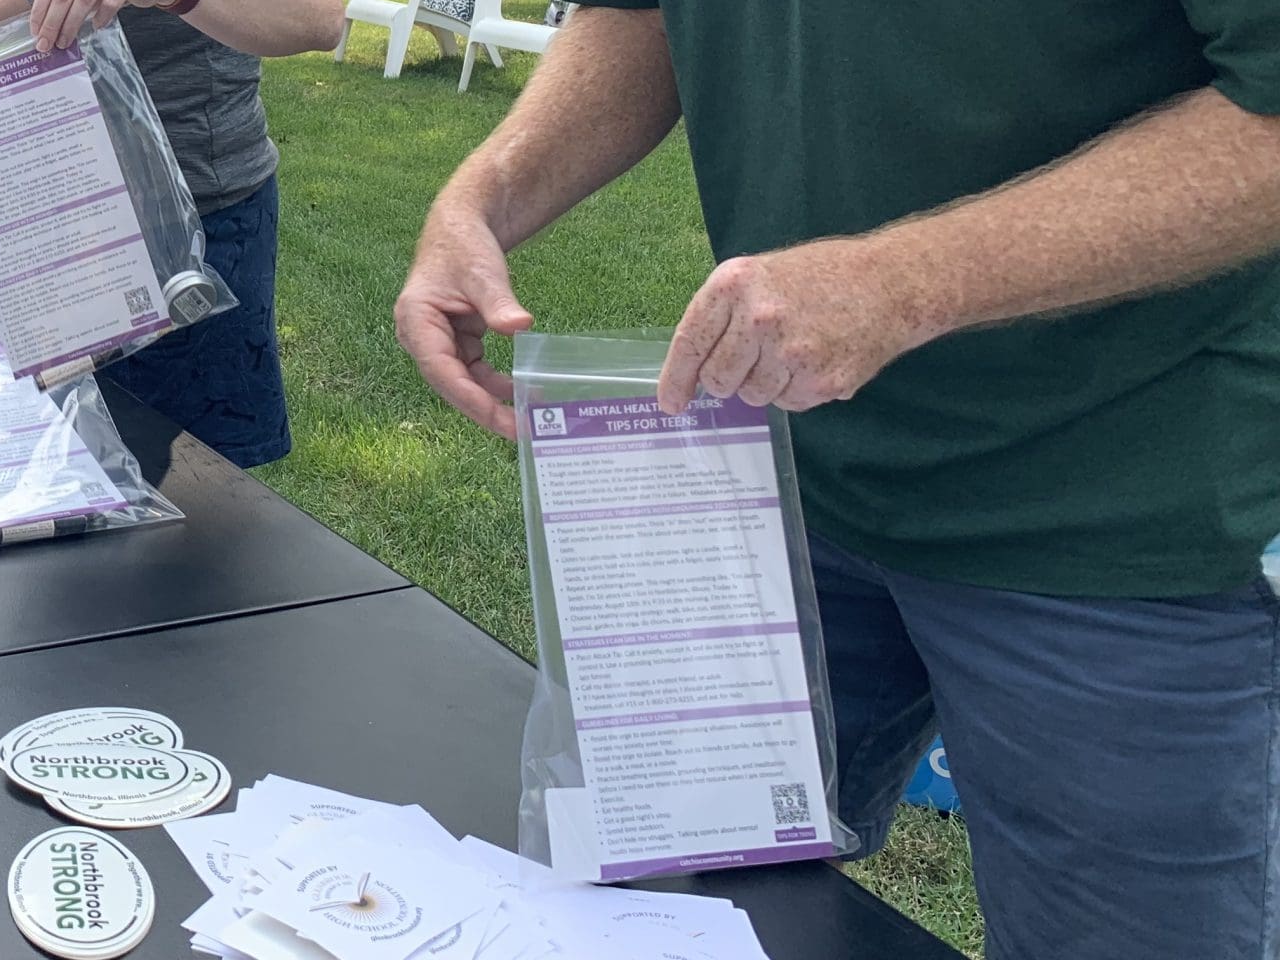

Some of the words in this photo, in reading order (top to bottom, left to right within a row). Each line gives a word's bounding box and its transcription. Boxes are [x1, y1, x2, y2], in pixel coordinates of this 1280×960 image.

[13, 65, 40, 79] TEENS
[579, 404, 621, 417] MENTAL
[623, 402, 659, 414] HEALT
[606, 419, 631, 432] TIPS
[633, 418, 658, 430] FOR
[659, 415, 698, 428] TEENS
[29, 754, 165, 766] Northbrook
[31, 764, 170, 780] STRONG
[117, 792, 147, 801] Illinois
[180, 799, 204, 814] Illinois
[310, 803, 357, 815] SUPPORTED
[50, 842, 85, 930] STRONG
[79, 841, 109, 930] Northbrook
[126, 861, 143, 888] Together
[136, 888, 144, 897] we
[297, 869, 326, 893] SUPPORTED
[323, 912, 350, 929] HIGH
[354, 921, 396, 933] SCHOOL
